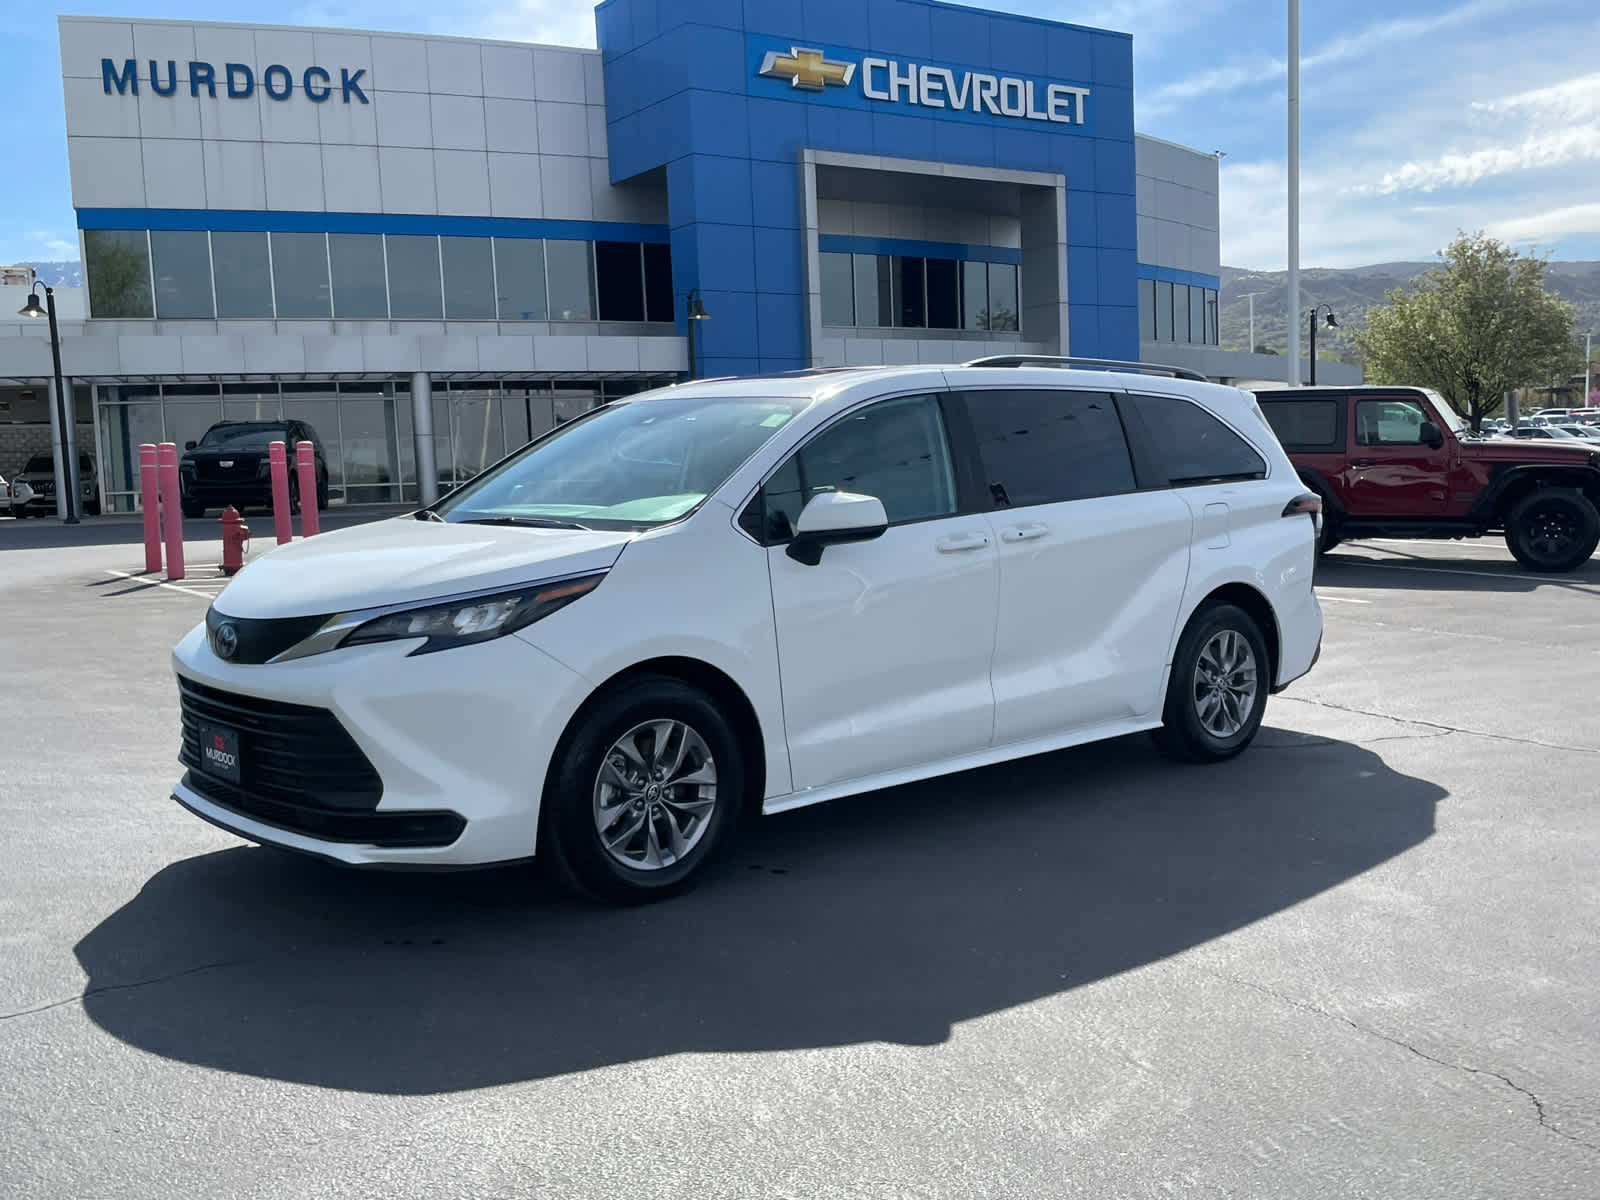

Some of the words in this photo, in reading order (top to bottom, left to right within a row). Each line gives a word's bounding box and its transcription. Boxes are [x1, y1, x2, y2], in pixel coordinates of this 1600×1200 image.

[101, 58, 370, 104] MURDOCK
[862, 57, 1090, 125] CHEVROLET
[205, 746, 236, 768] MURDOCK
